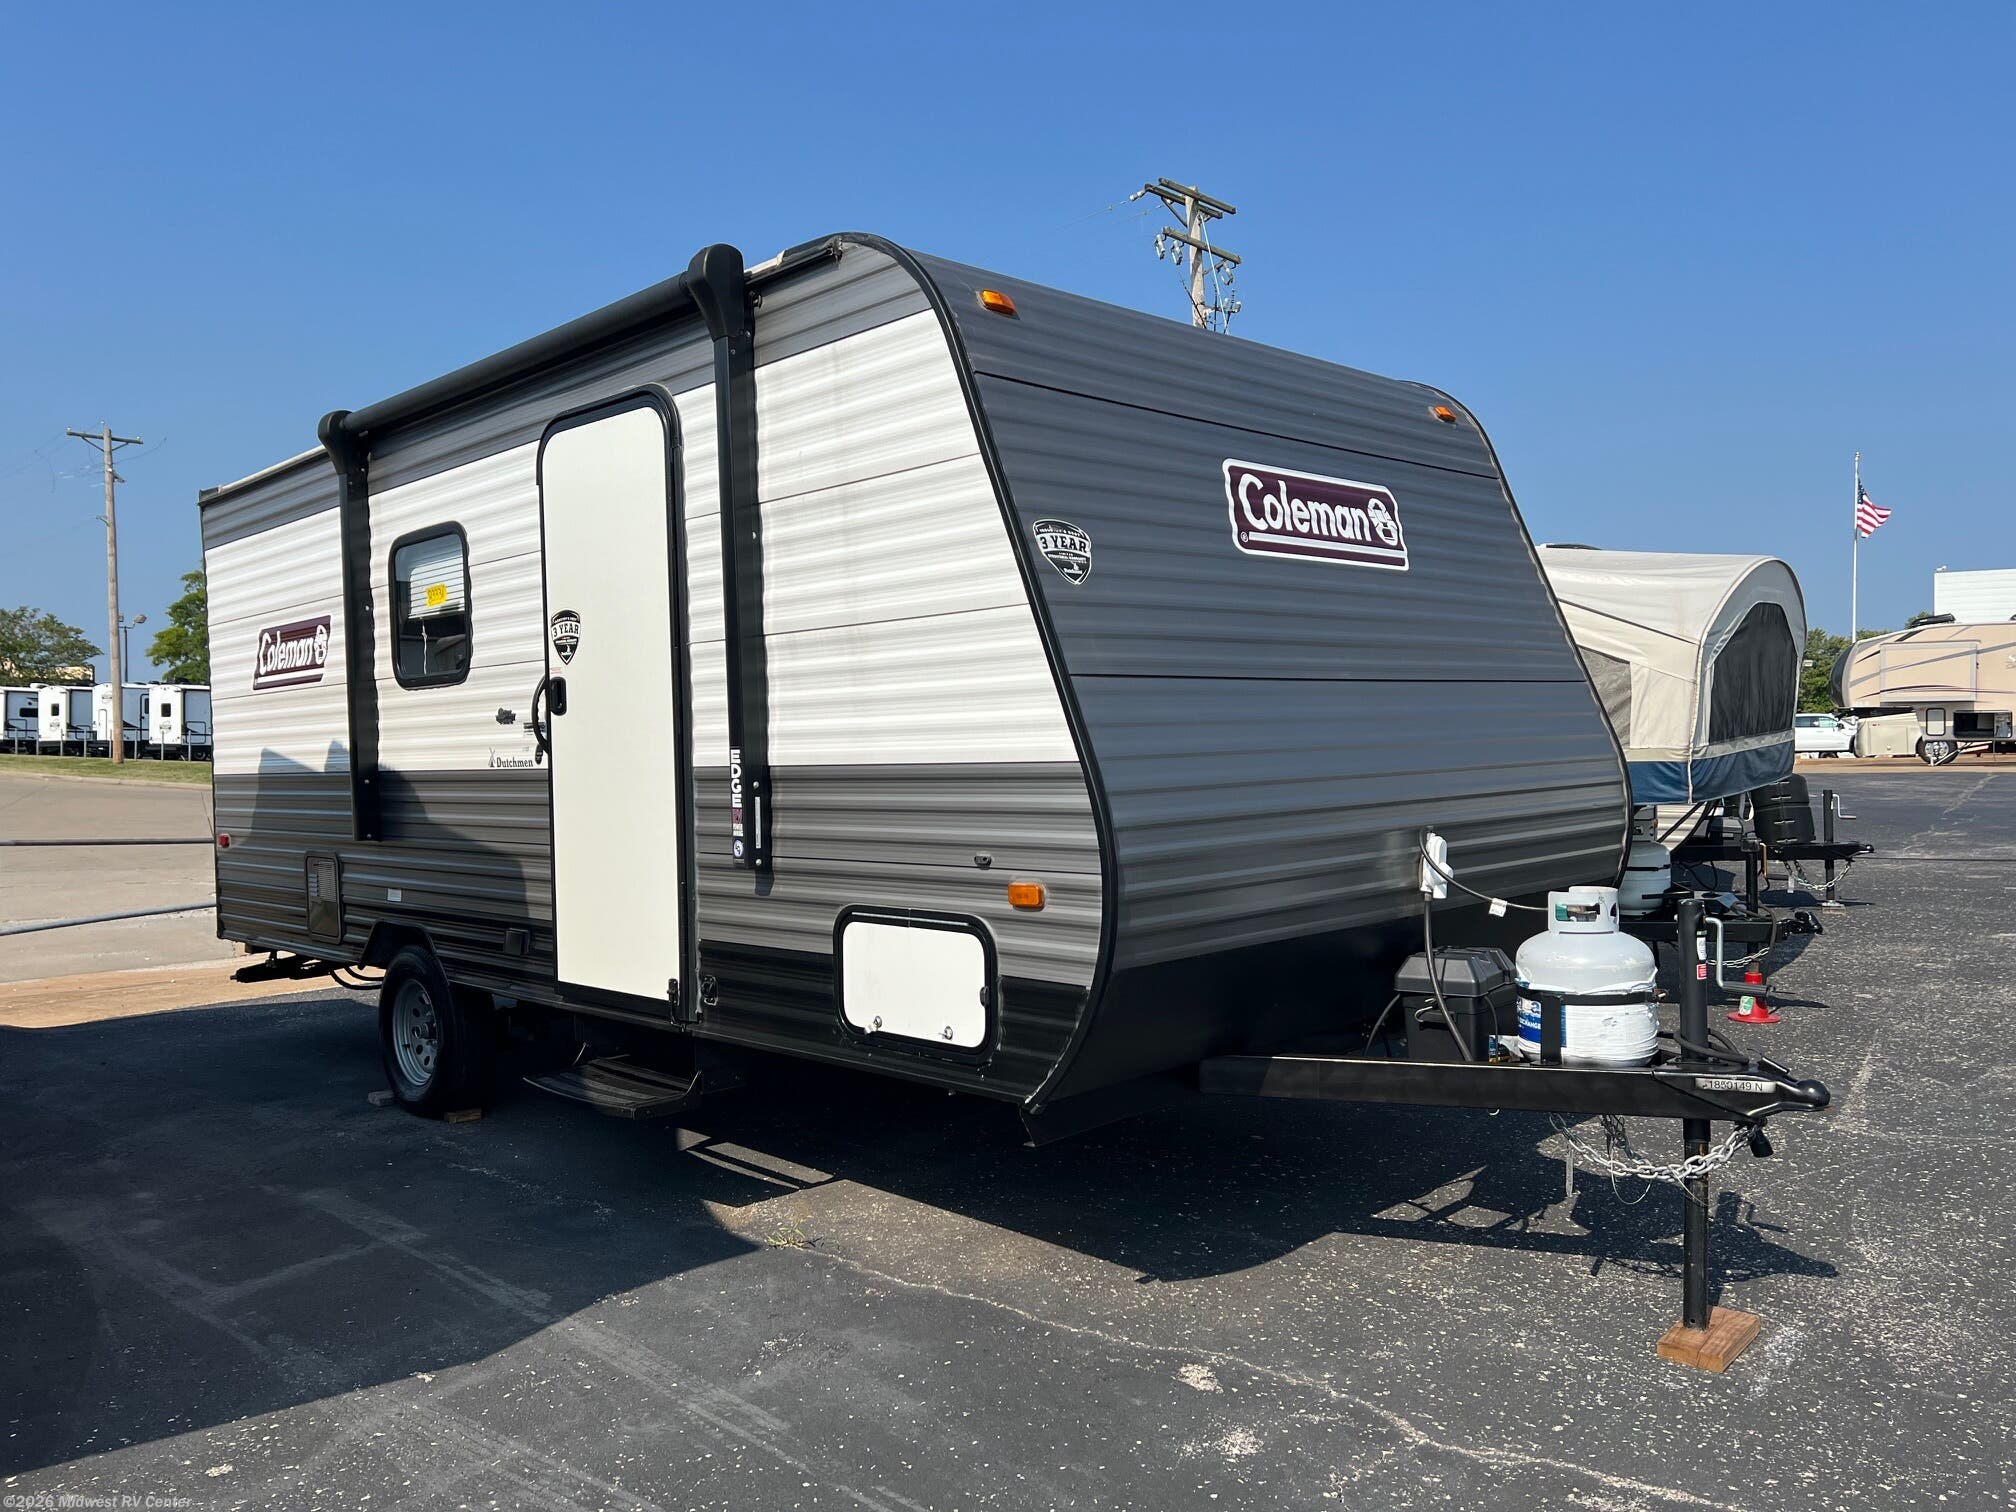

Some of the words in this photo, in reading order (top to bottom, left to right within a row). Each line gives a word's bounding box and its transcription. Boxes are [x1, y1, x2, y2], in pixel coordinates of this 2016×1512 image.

[1238, 473, 1372, 542] Coleman
[1040, 536, 1049, 550] 3
[1050, 534, 1087, 554] YEAR
[552, 626, 558, 638] 3
[559, 622, 579, 635] YEAR
[259, 630, 314, 675] Coleman
[496, 755, 534, 768] Dutchmen
[730, 748, 743, 809] EDGE
[1755, 1083, 1763, 1092] N
